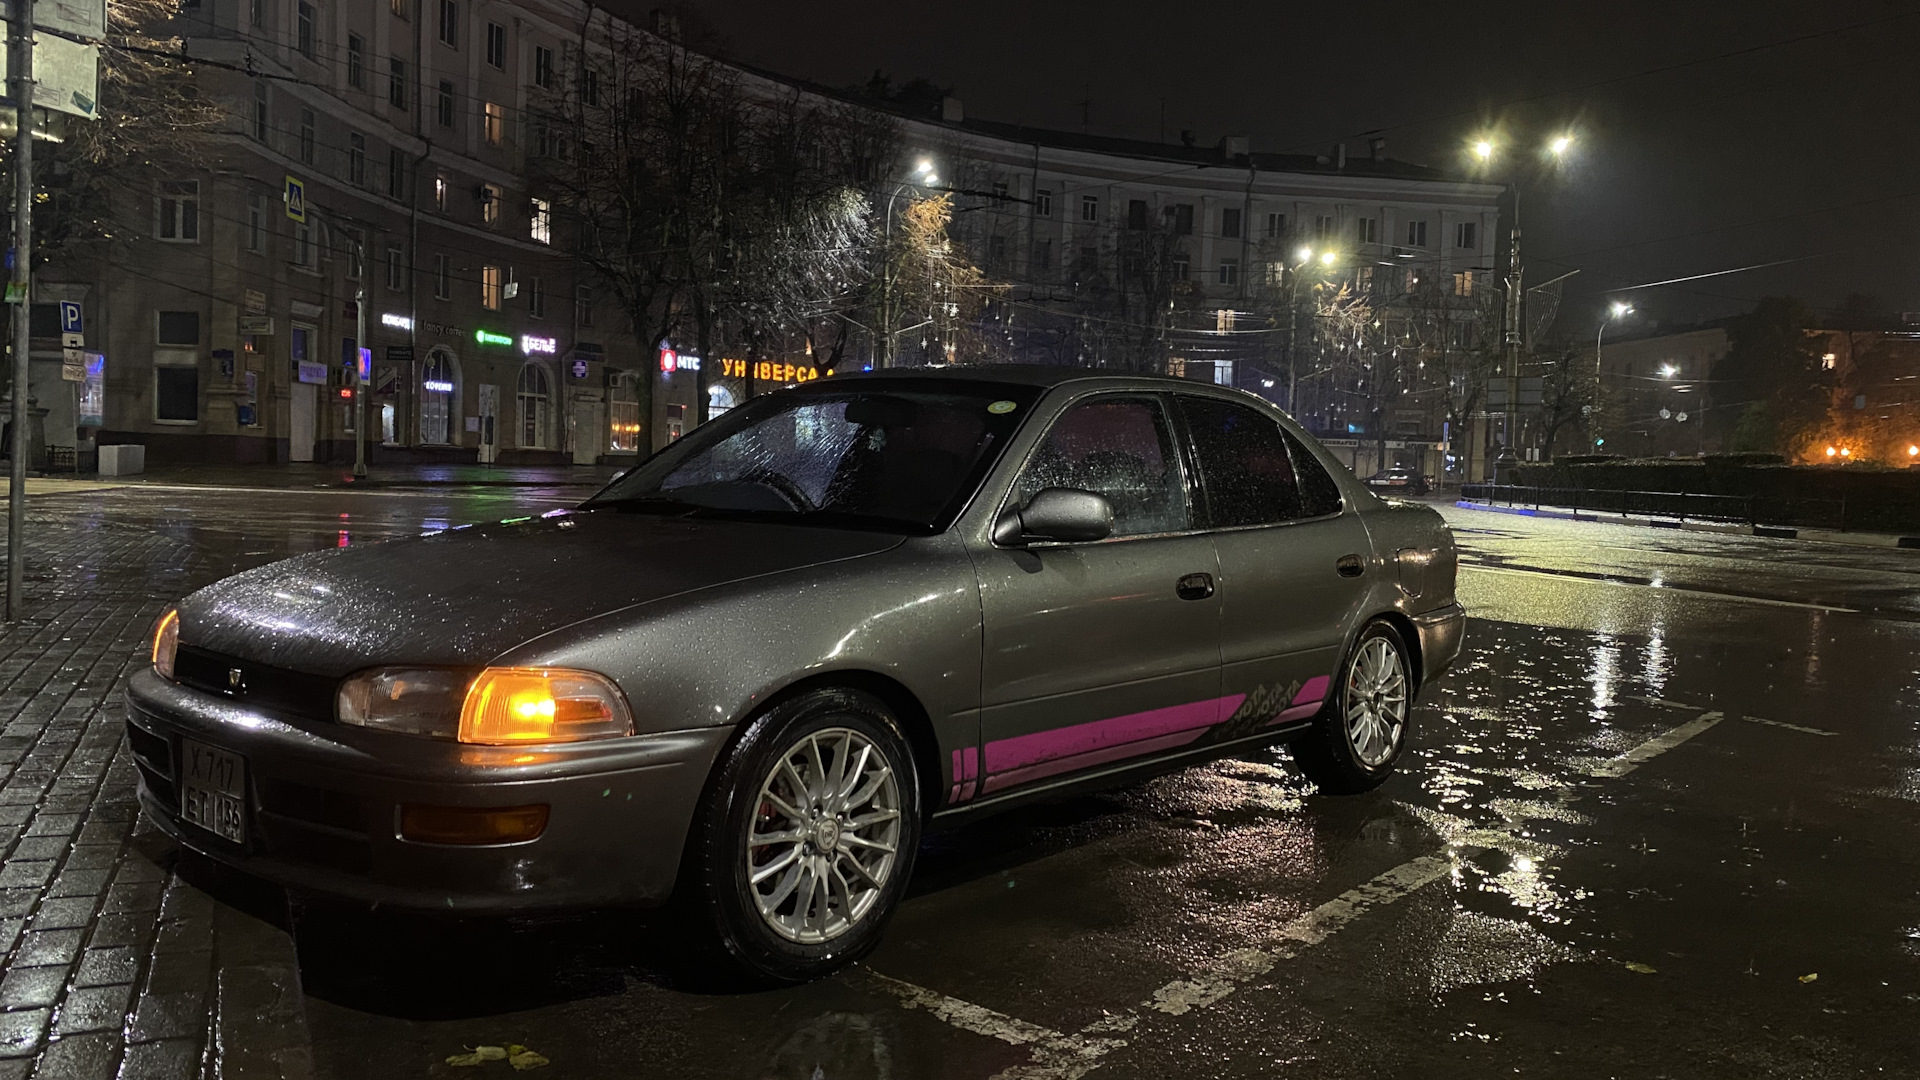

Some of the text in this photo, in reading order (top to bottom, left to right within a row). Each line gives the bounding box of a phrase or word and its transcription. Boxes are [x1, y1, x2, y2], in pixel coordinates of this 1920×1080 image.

[66, 305, 79, 330] P
[423, 320, 444, 336] fancy
[677, 355, 701, 371] МТС
[722, 357, 834, 382] УНВЕРСА
[206, 751, 234, 790] 717
[217, 796, 241, 829] 136
